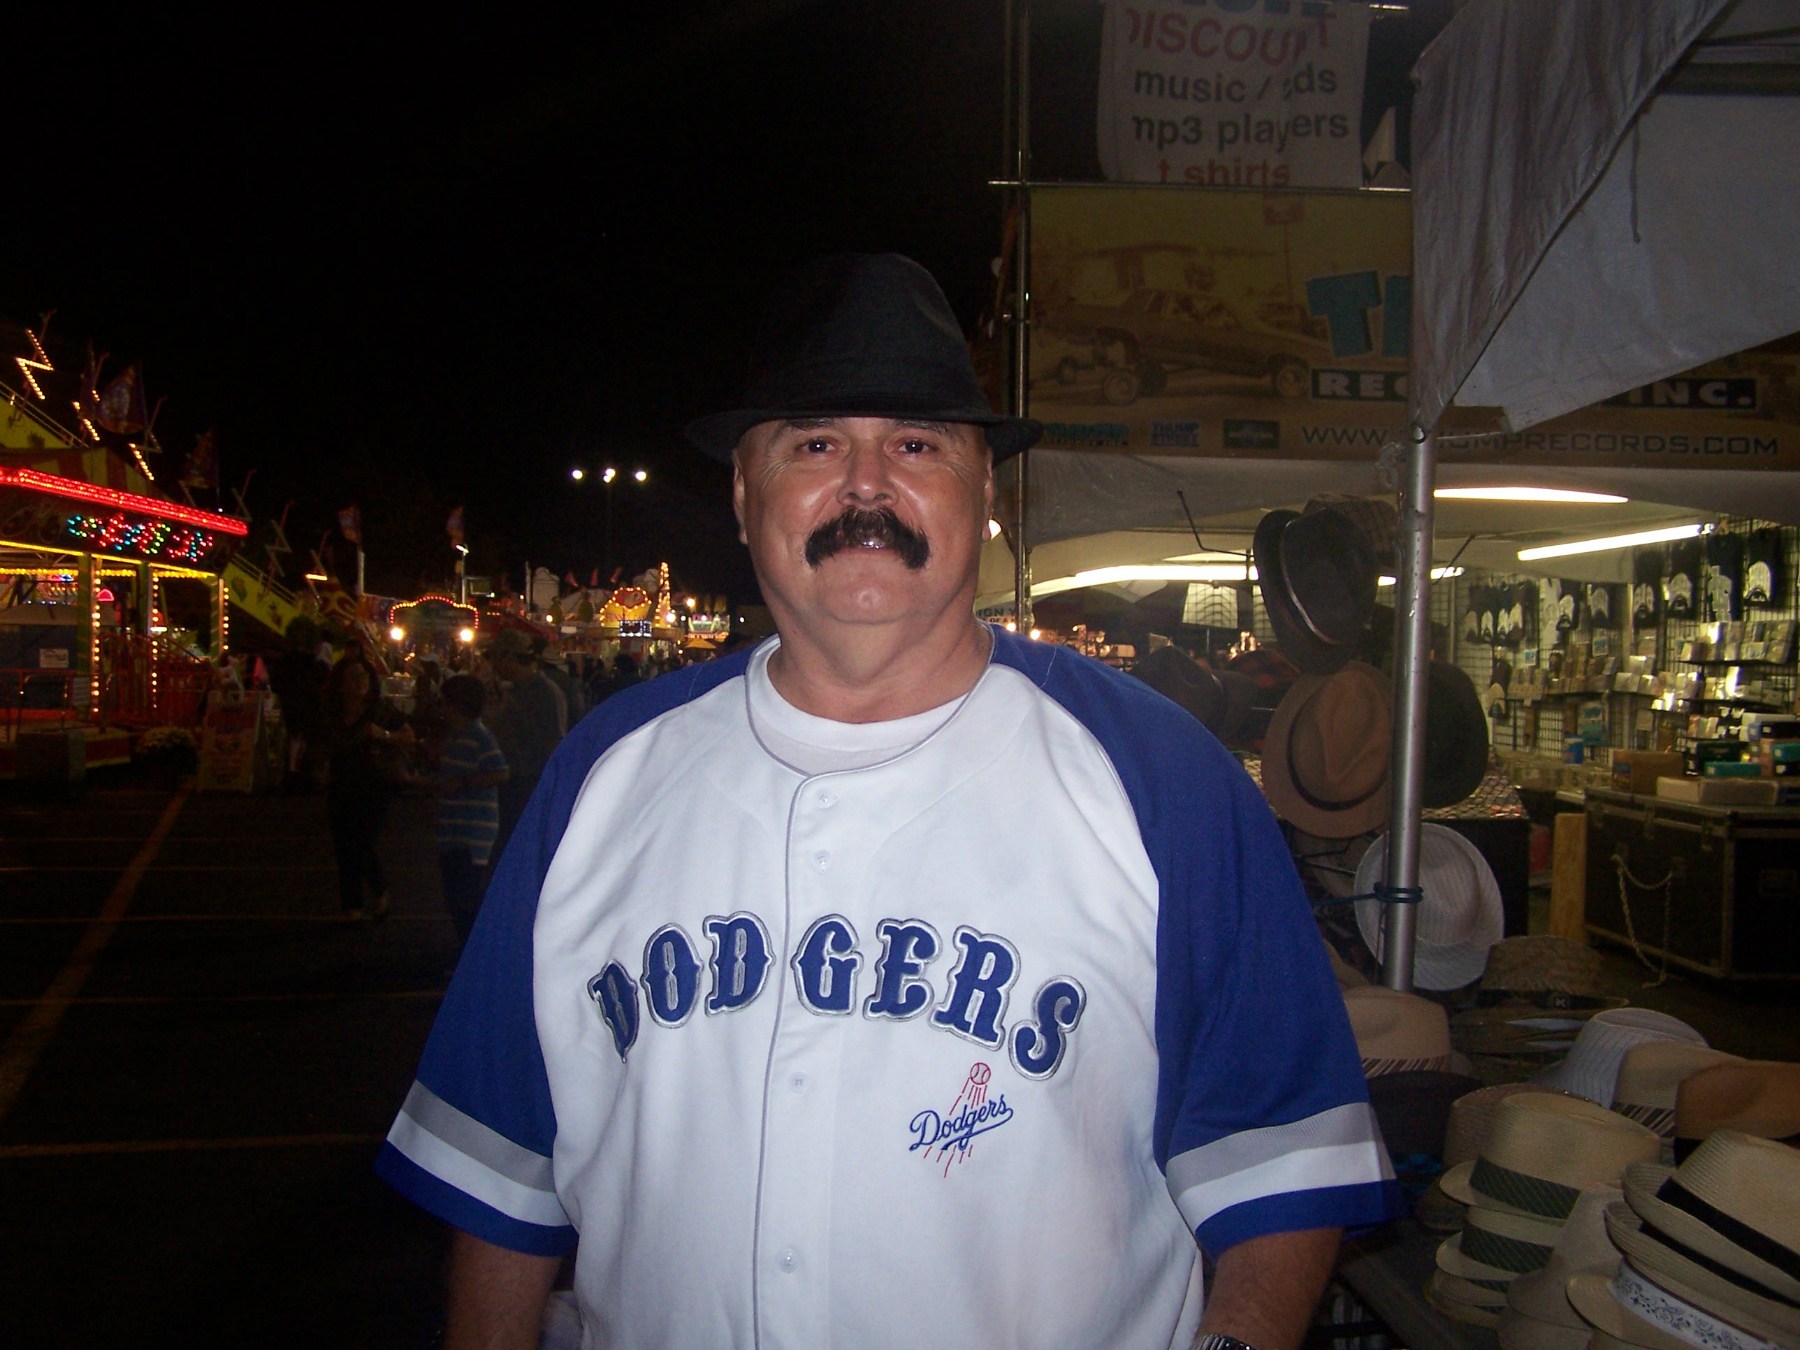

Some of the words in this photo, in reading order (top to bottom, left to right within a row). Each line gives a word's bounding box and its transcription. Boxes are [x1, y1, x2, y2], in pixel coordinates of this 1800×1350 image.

[1134, 69, 1246, 102] music
[1217, 112, 1350, 152] players
[588, 911, 1087, 1081] DODGERS
[908, 1094, 1014, 1151] Dodgers
